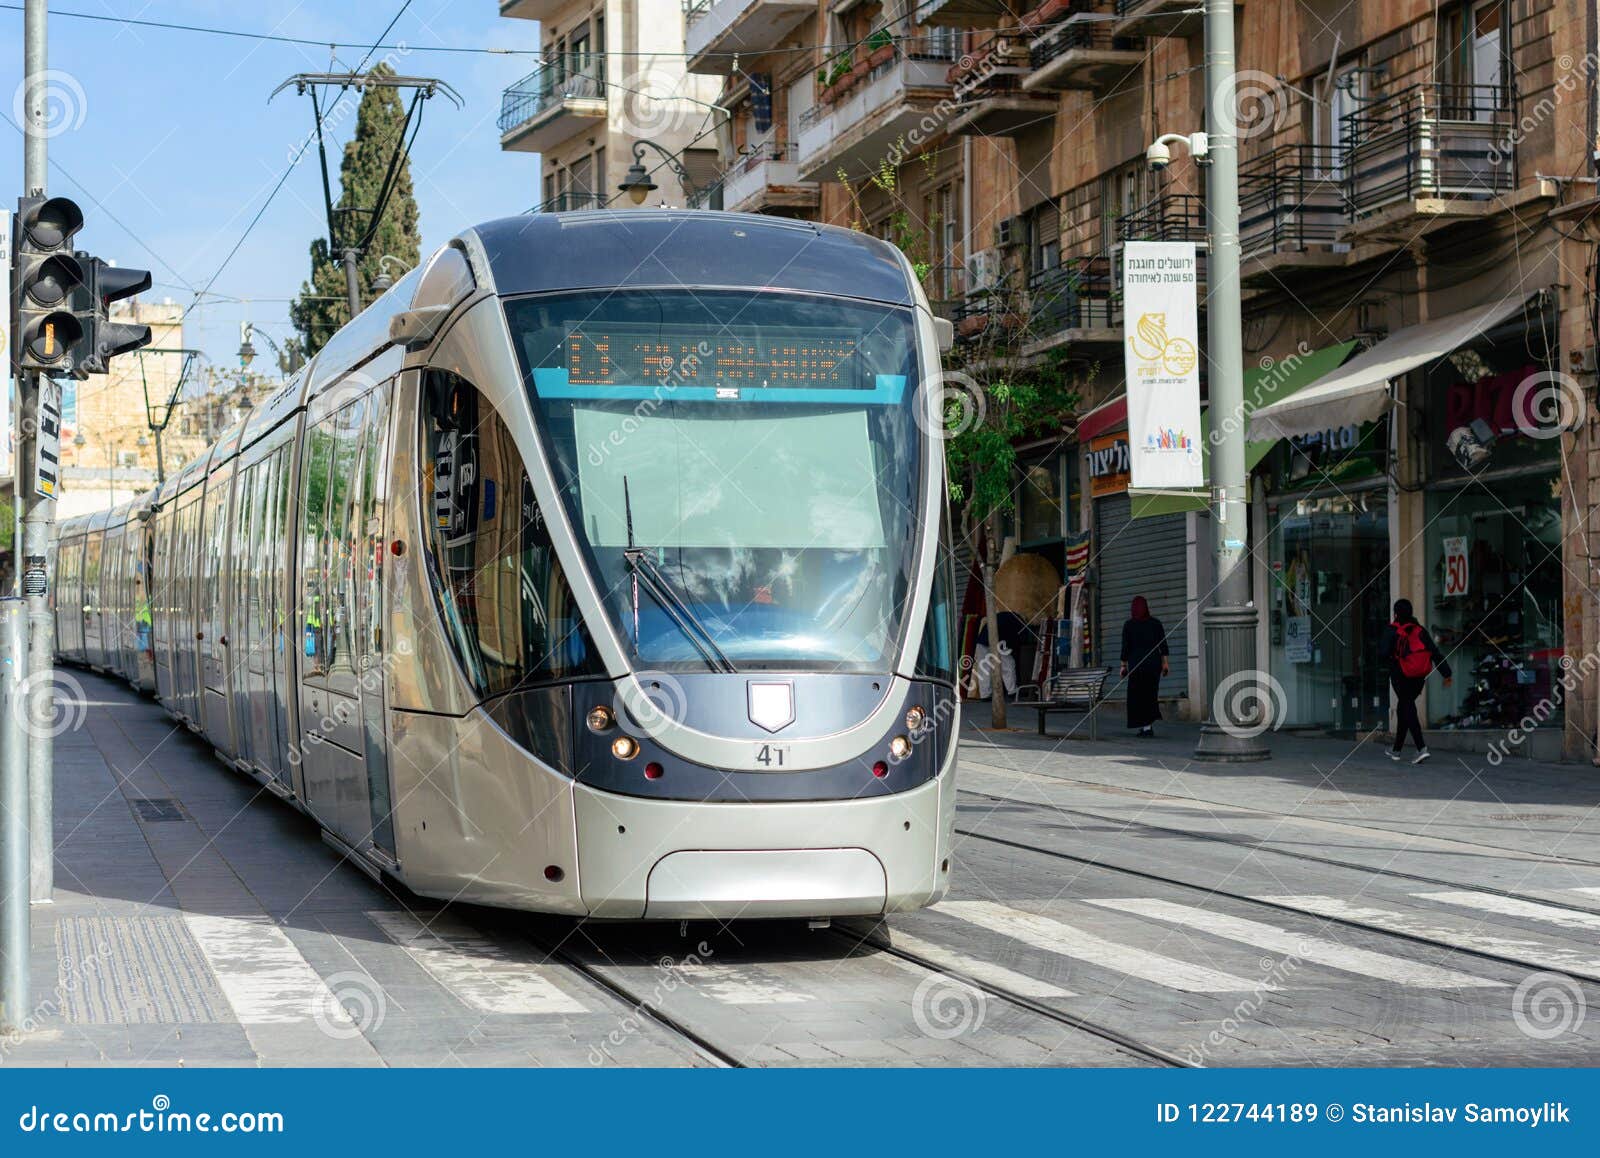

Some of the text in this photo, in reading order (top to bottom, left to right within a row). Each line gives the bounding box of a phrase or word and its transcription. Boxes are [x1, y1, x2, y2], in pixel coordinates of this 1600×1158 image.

[1129, 257, 1193, 269] ירושלים חוגגת
[1128, 272, 1194, 283] 50 שנה לאיחודה
[1447, 553, 1467, 593] 50
